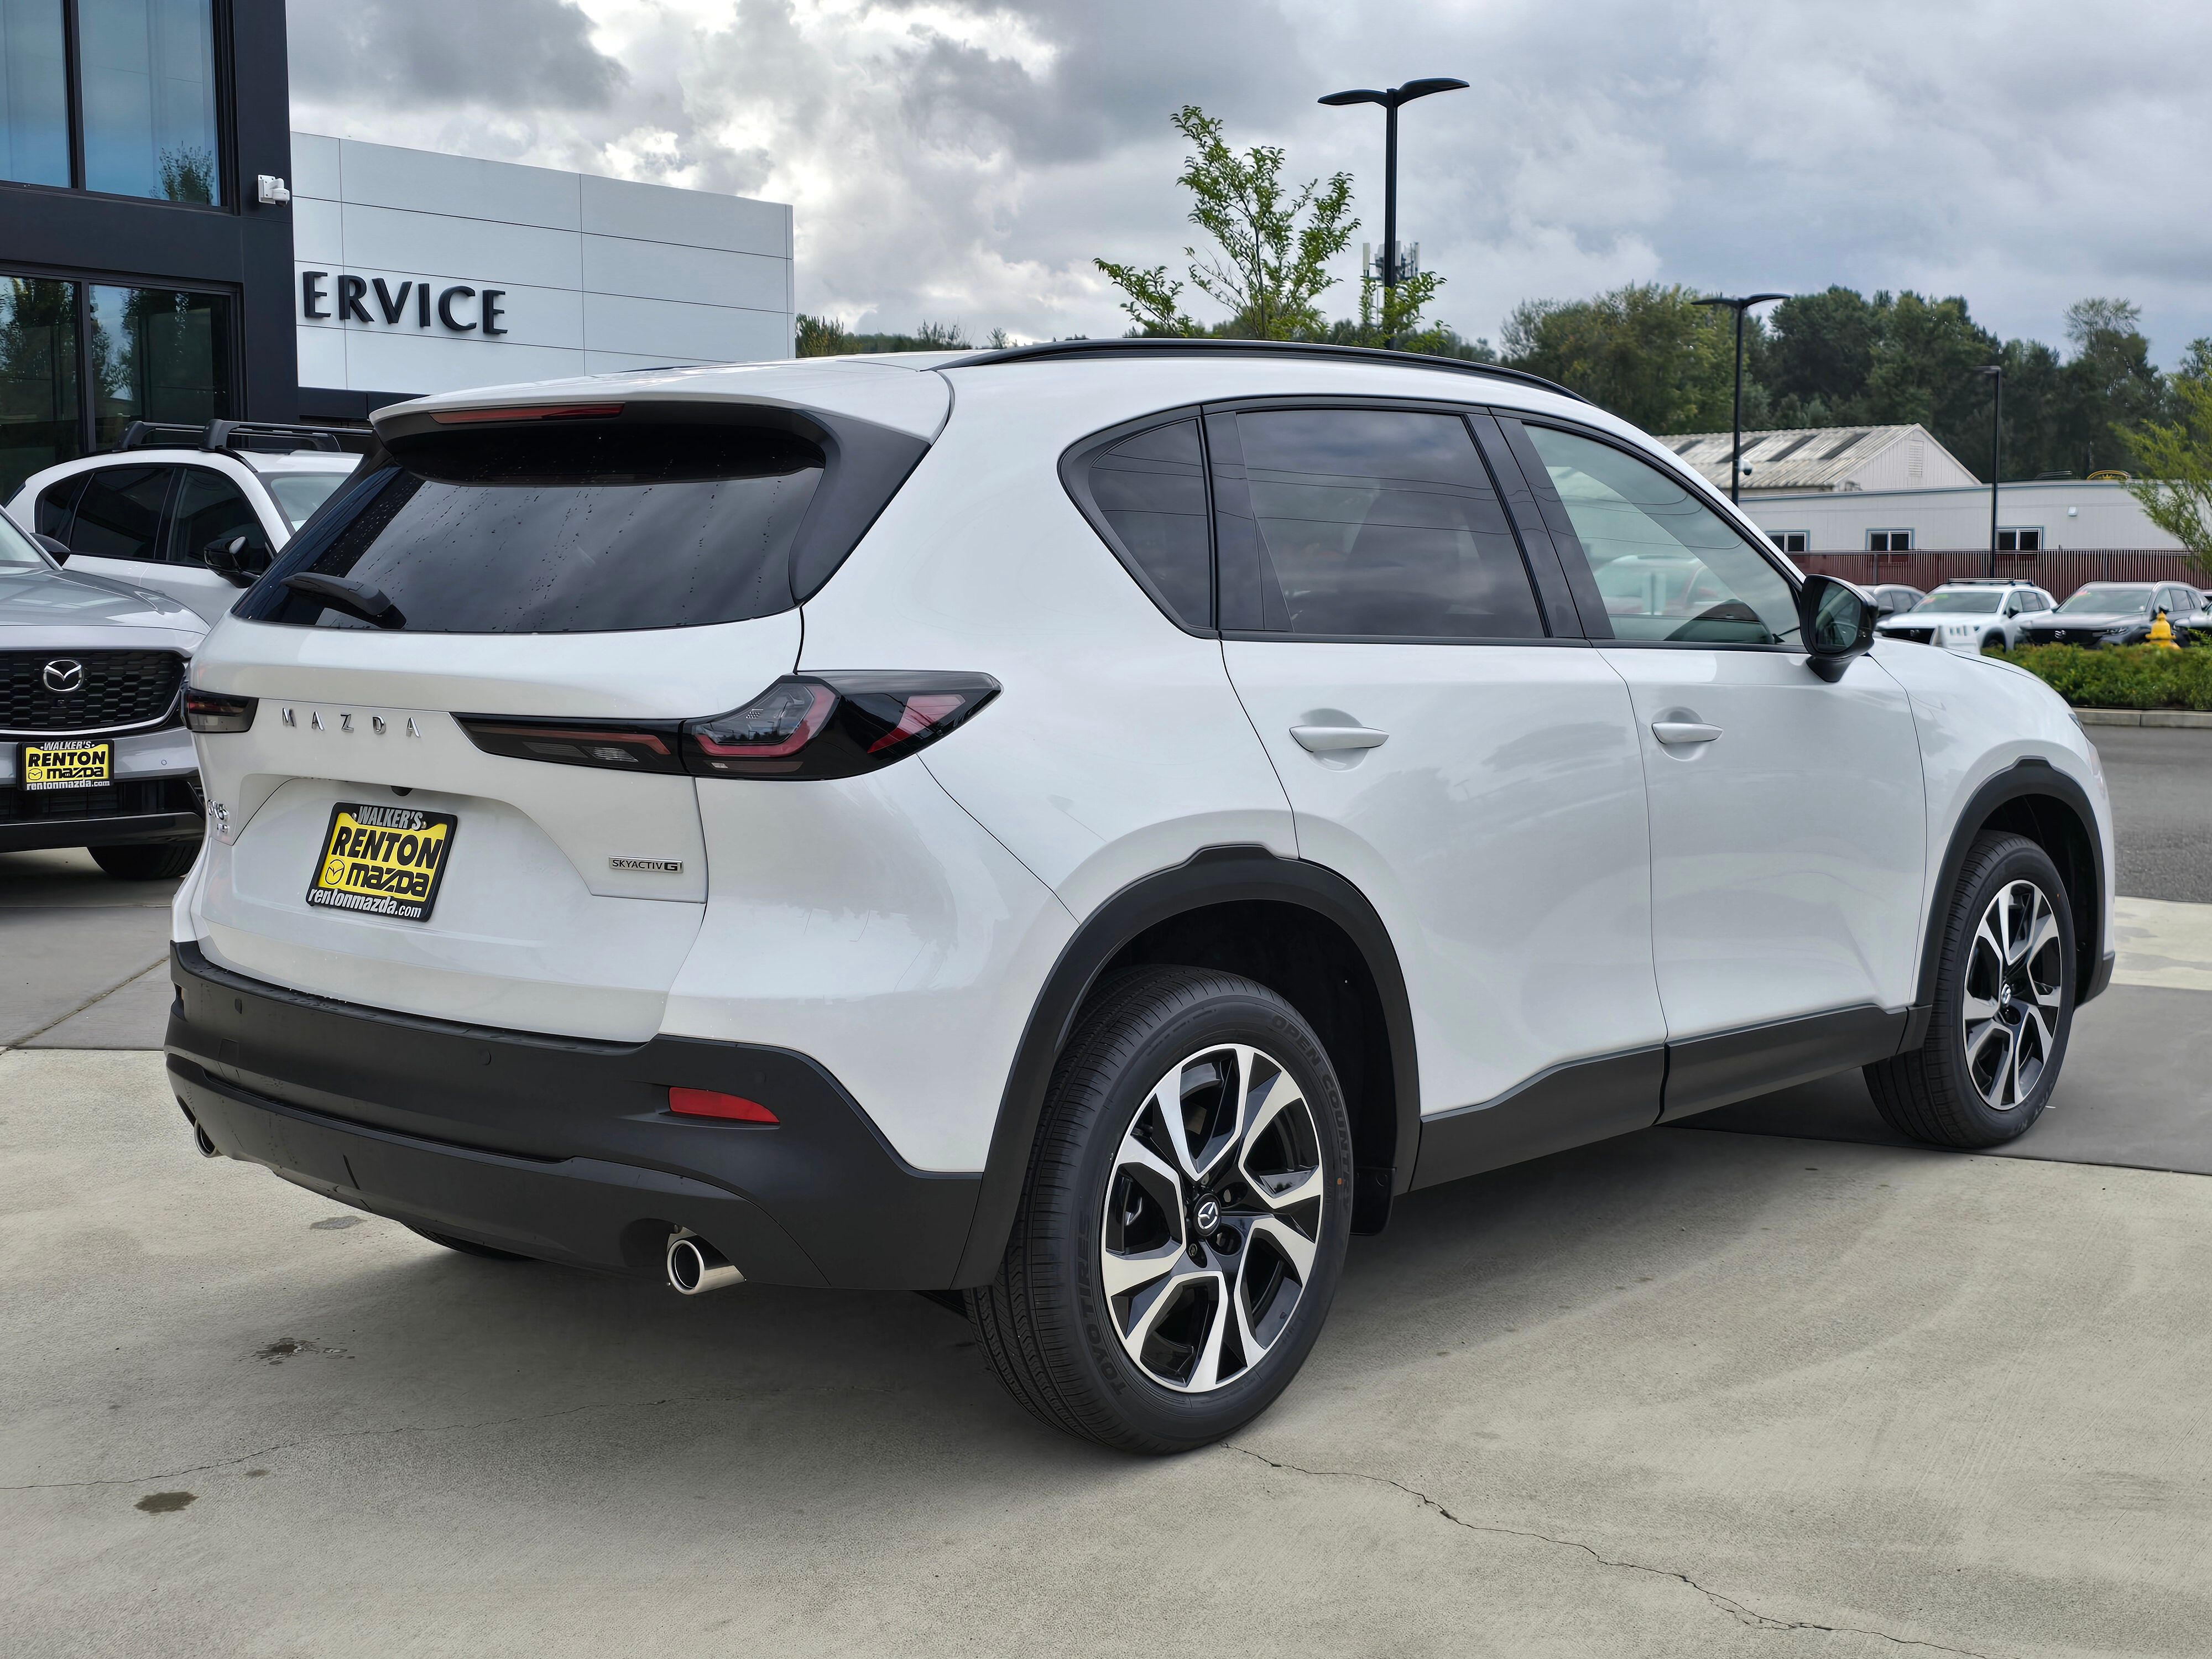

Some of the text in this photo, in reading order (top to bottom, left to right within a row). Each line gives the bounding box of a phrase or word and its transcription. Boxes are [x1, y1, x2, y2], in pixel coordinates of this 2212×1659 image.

[302, 271, 508, 334] ERVICE
[282, 707, 420, 738] MAZDA
[28, 751, 106, 767] RENTON
[44, 741, 92, 751] WALKER'S
[27, 779, 110, 790] rentonmazda.com
[358, 806, 423, 830] WALKER'S
[331, 826, 443, 869] RENTON
[308, 889, 421, 918] rentonmazda.com
[1271, 1015, 1321, 1067] OPEN
[1086, 1323, 1126, 1395] TOYO
